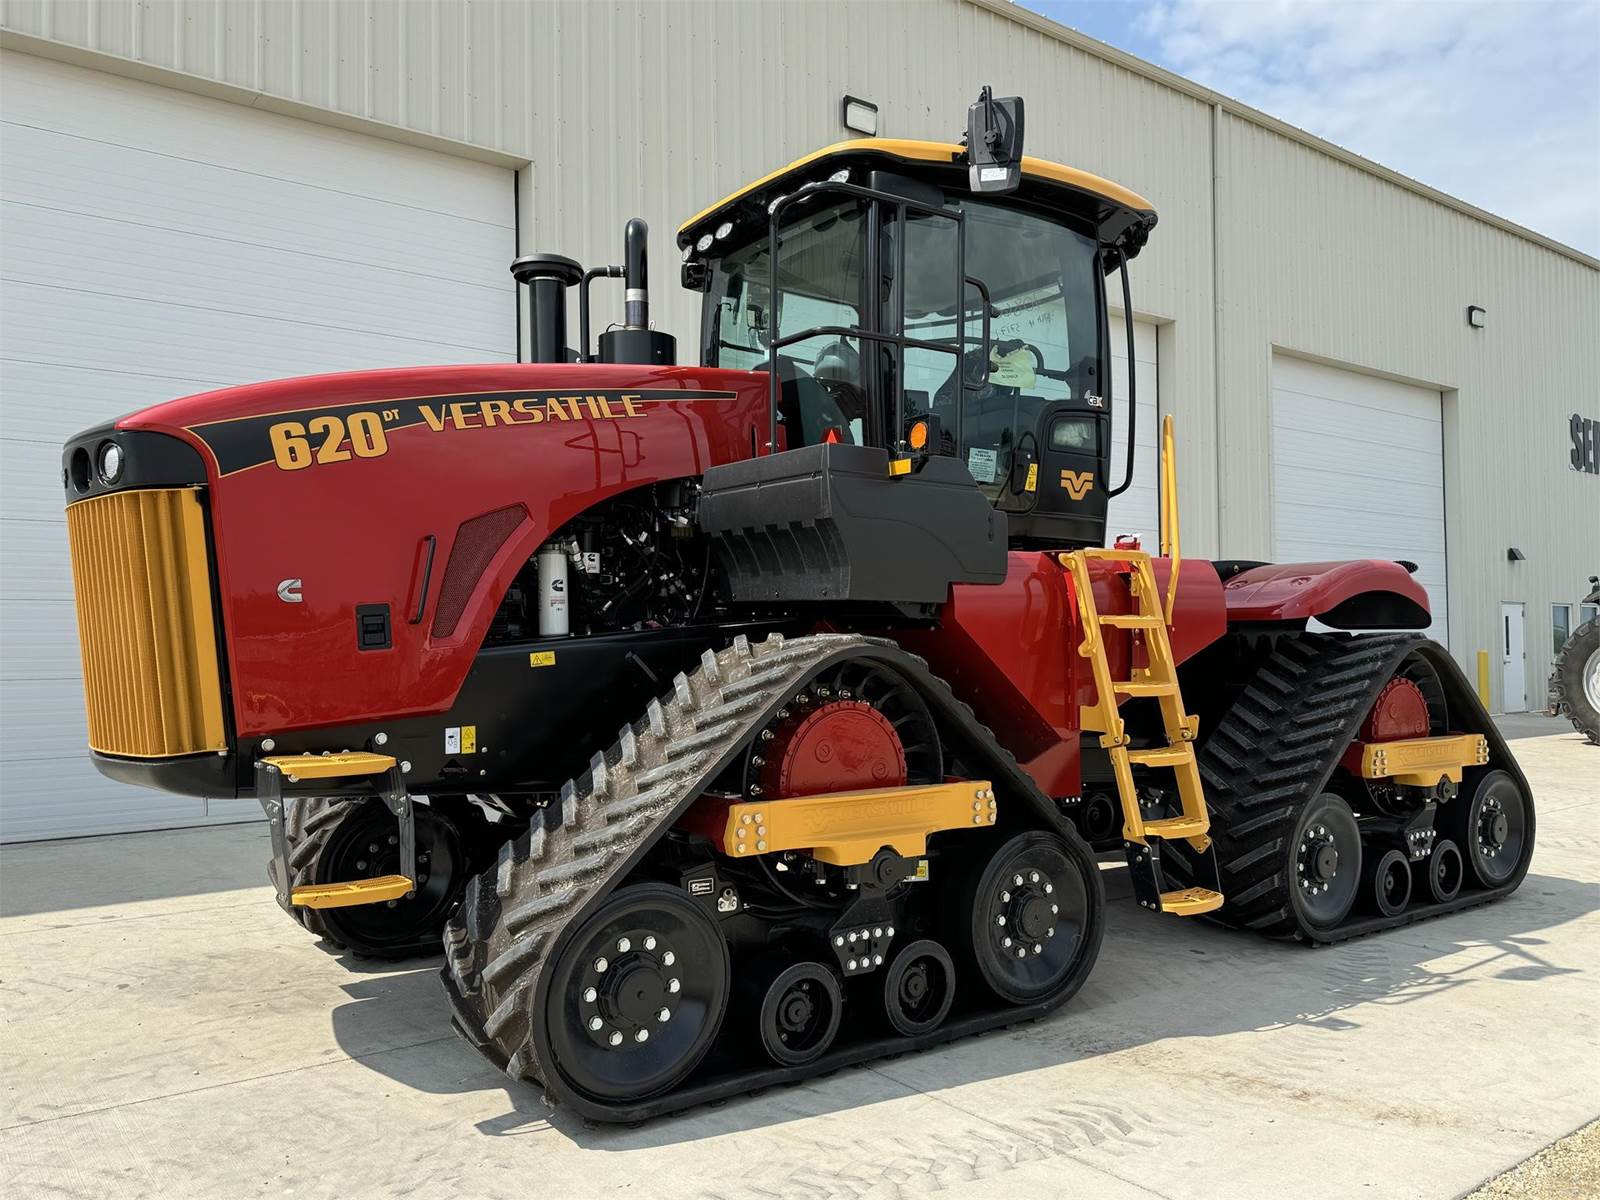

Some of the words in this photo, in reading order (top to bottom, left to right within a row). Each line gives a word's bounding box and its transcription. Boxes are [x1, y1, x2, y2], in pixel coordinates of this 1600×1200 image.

[269, 411, 389, 471] 620
[382, 408, 400, 422] DT
[418, 394, 648, 432] VERSATILE
